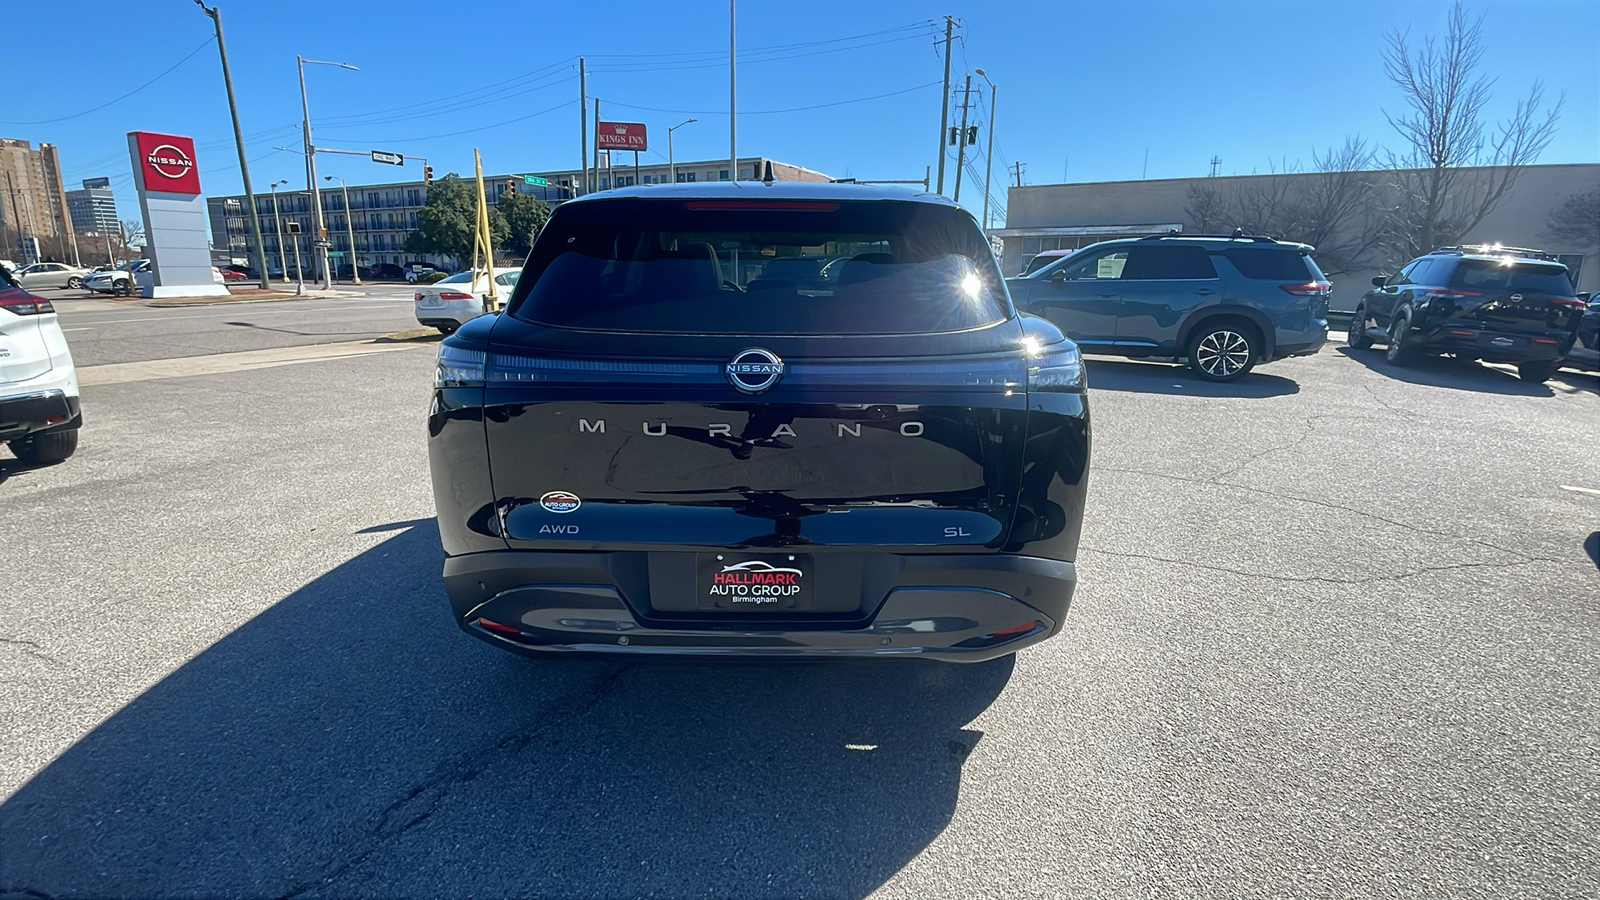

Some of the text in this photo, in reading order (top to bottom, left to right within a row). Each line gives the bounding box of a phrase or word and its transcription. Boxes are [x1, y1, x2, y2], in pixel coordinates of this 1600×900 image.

[599, 134, 644, 145] KINGS INN
[148, 156, 192, 166] NISSAN
[727, 365, 781, 373] NISSAN
[579, 418, 925, 438] MURANO
[539, 524, 579, 534] AWD
[944, 526, 971, 537] SL
[714, 573, 796, 584] HALLMARK
[709, 585, 800, 596] AUTO GROUP
[732, 596, 778, 604] Birmingham
